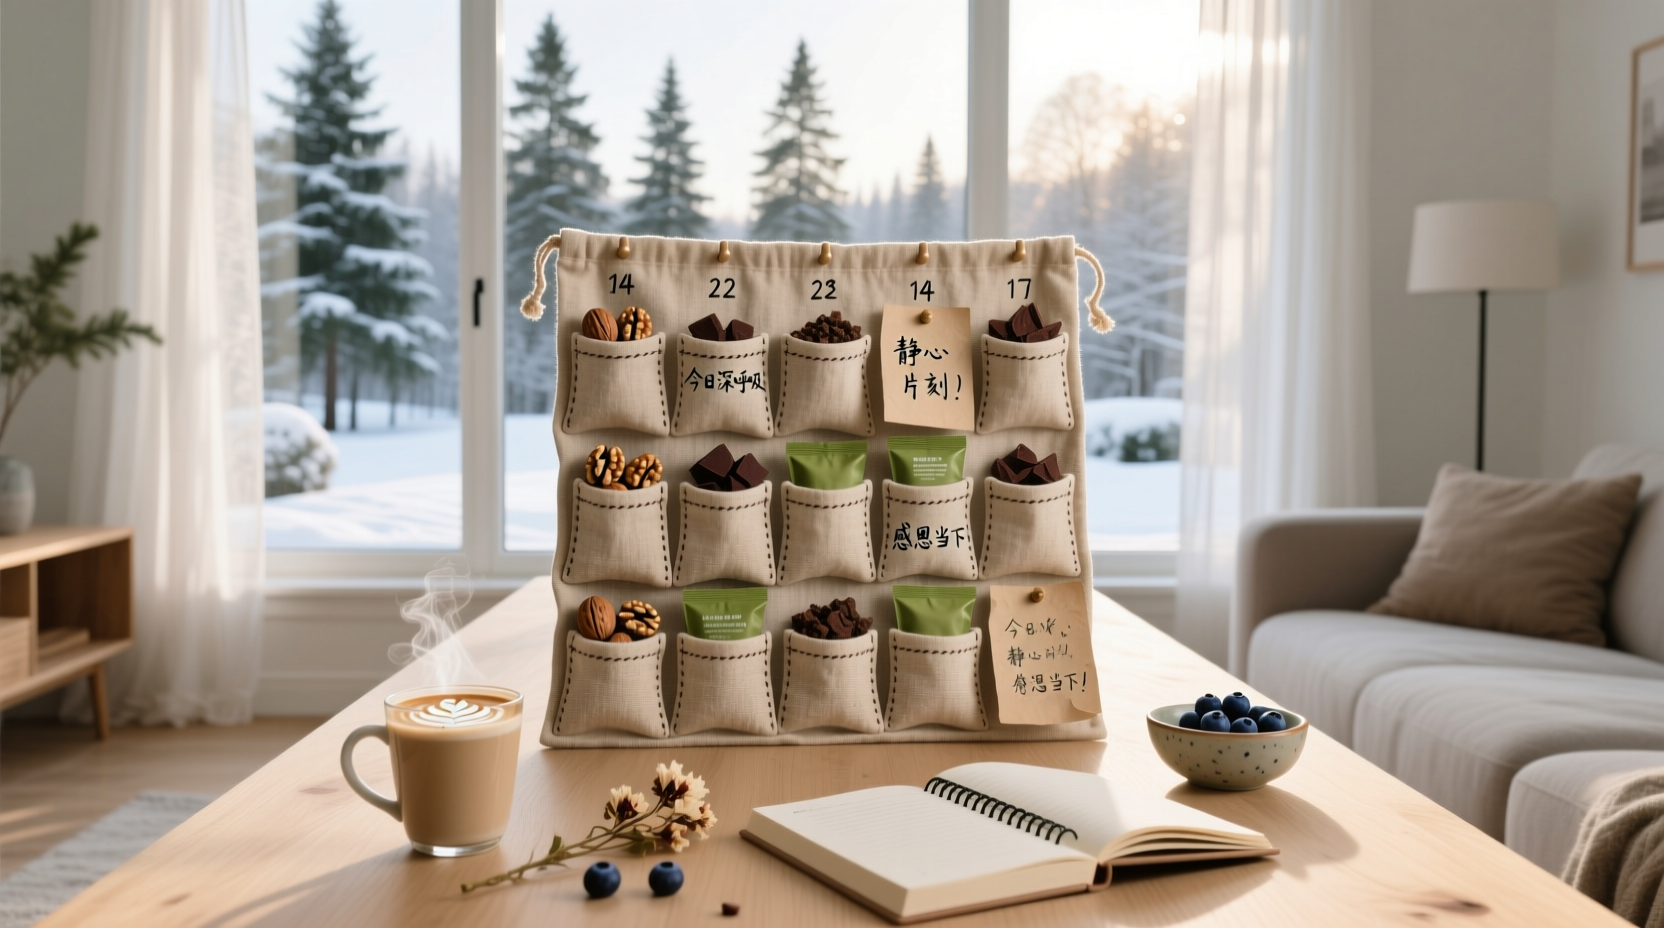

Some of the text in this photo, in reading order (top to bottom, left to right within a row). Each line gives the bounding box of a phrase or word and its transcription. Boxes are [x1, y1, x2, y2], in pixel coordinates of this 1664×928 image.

[608, 273, 634, 295] 14
[708, 277, 736, 298] 22
[910, 280, 934, 302] 14
[1007, 278, 1032, 299] 17
[893, 336, 949, 366] 静心
